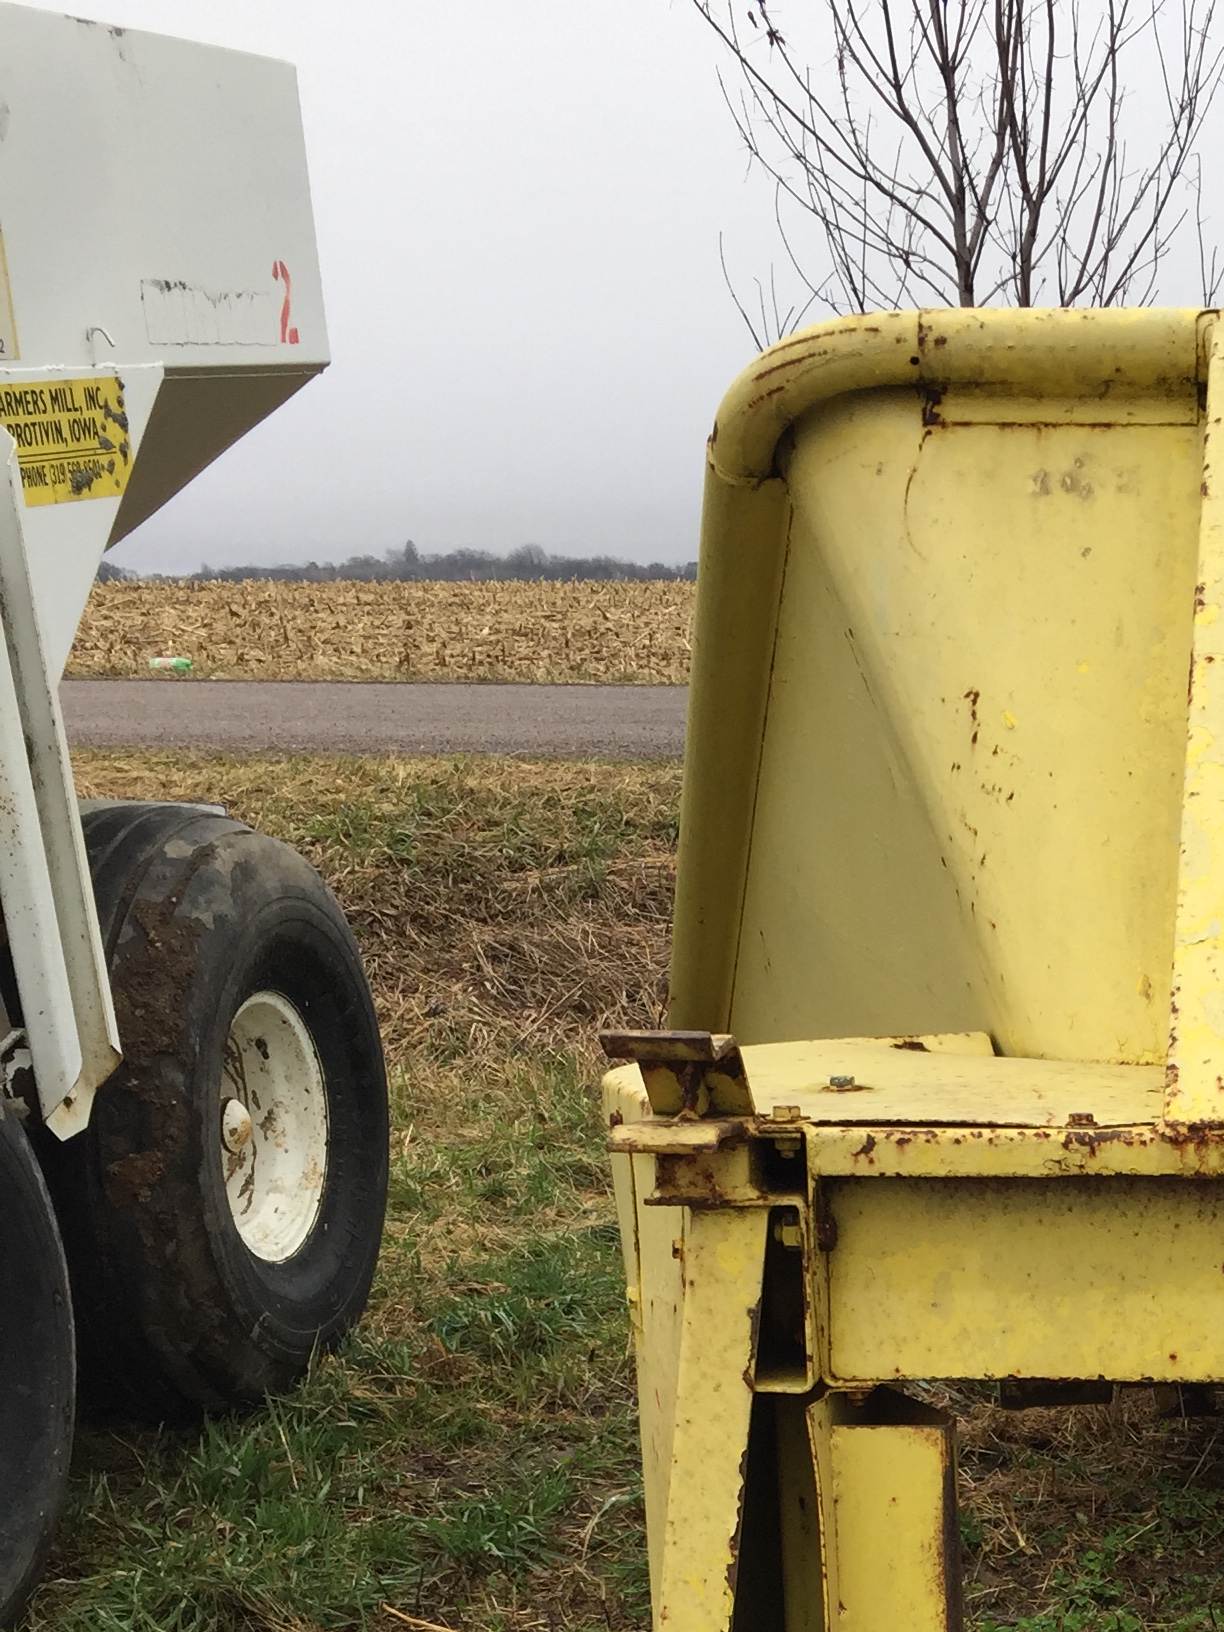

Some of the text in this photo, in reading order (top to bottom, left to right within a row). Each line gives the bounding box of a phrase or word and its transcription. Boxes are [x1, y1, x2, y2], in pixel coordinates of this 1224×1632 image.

[48, 387, 83, 416] MILL,
[7, 417, 101, 448] PROTIVIN, IOWA
[20, 464, 49, 488] PHONE
